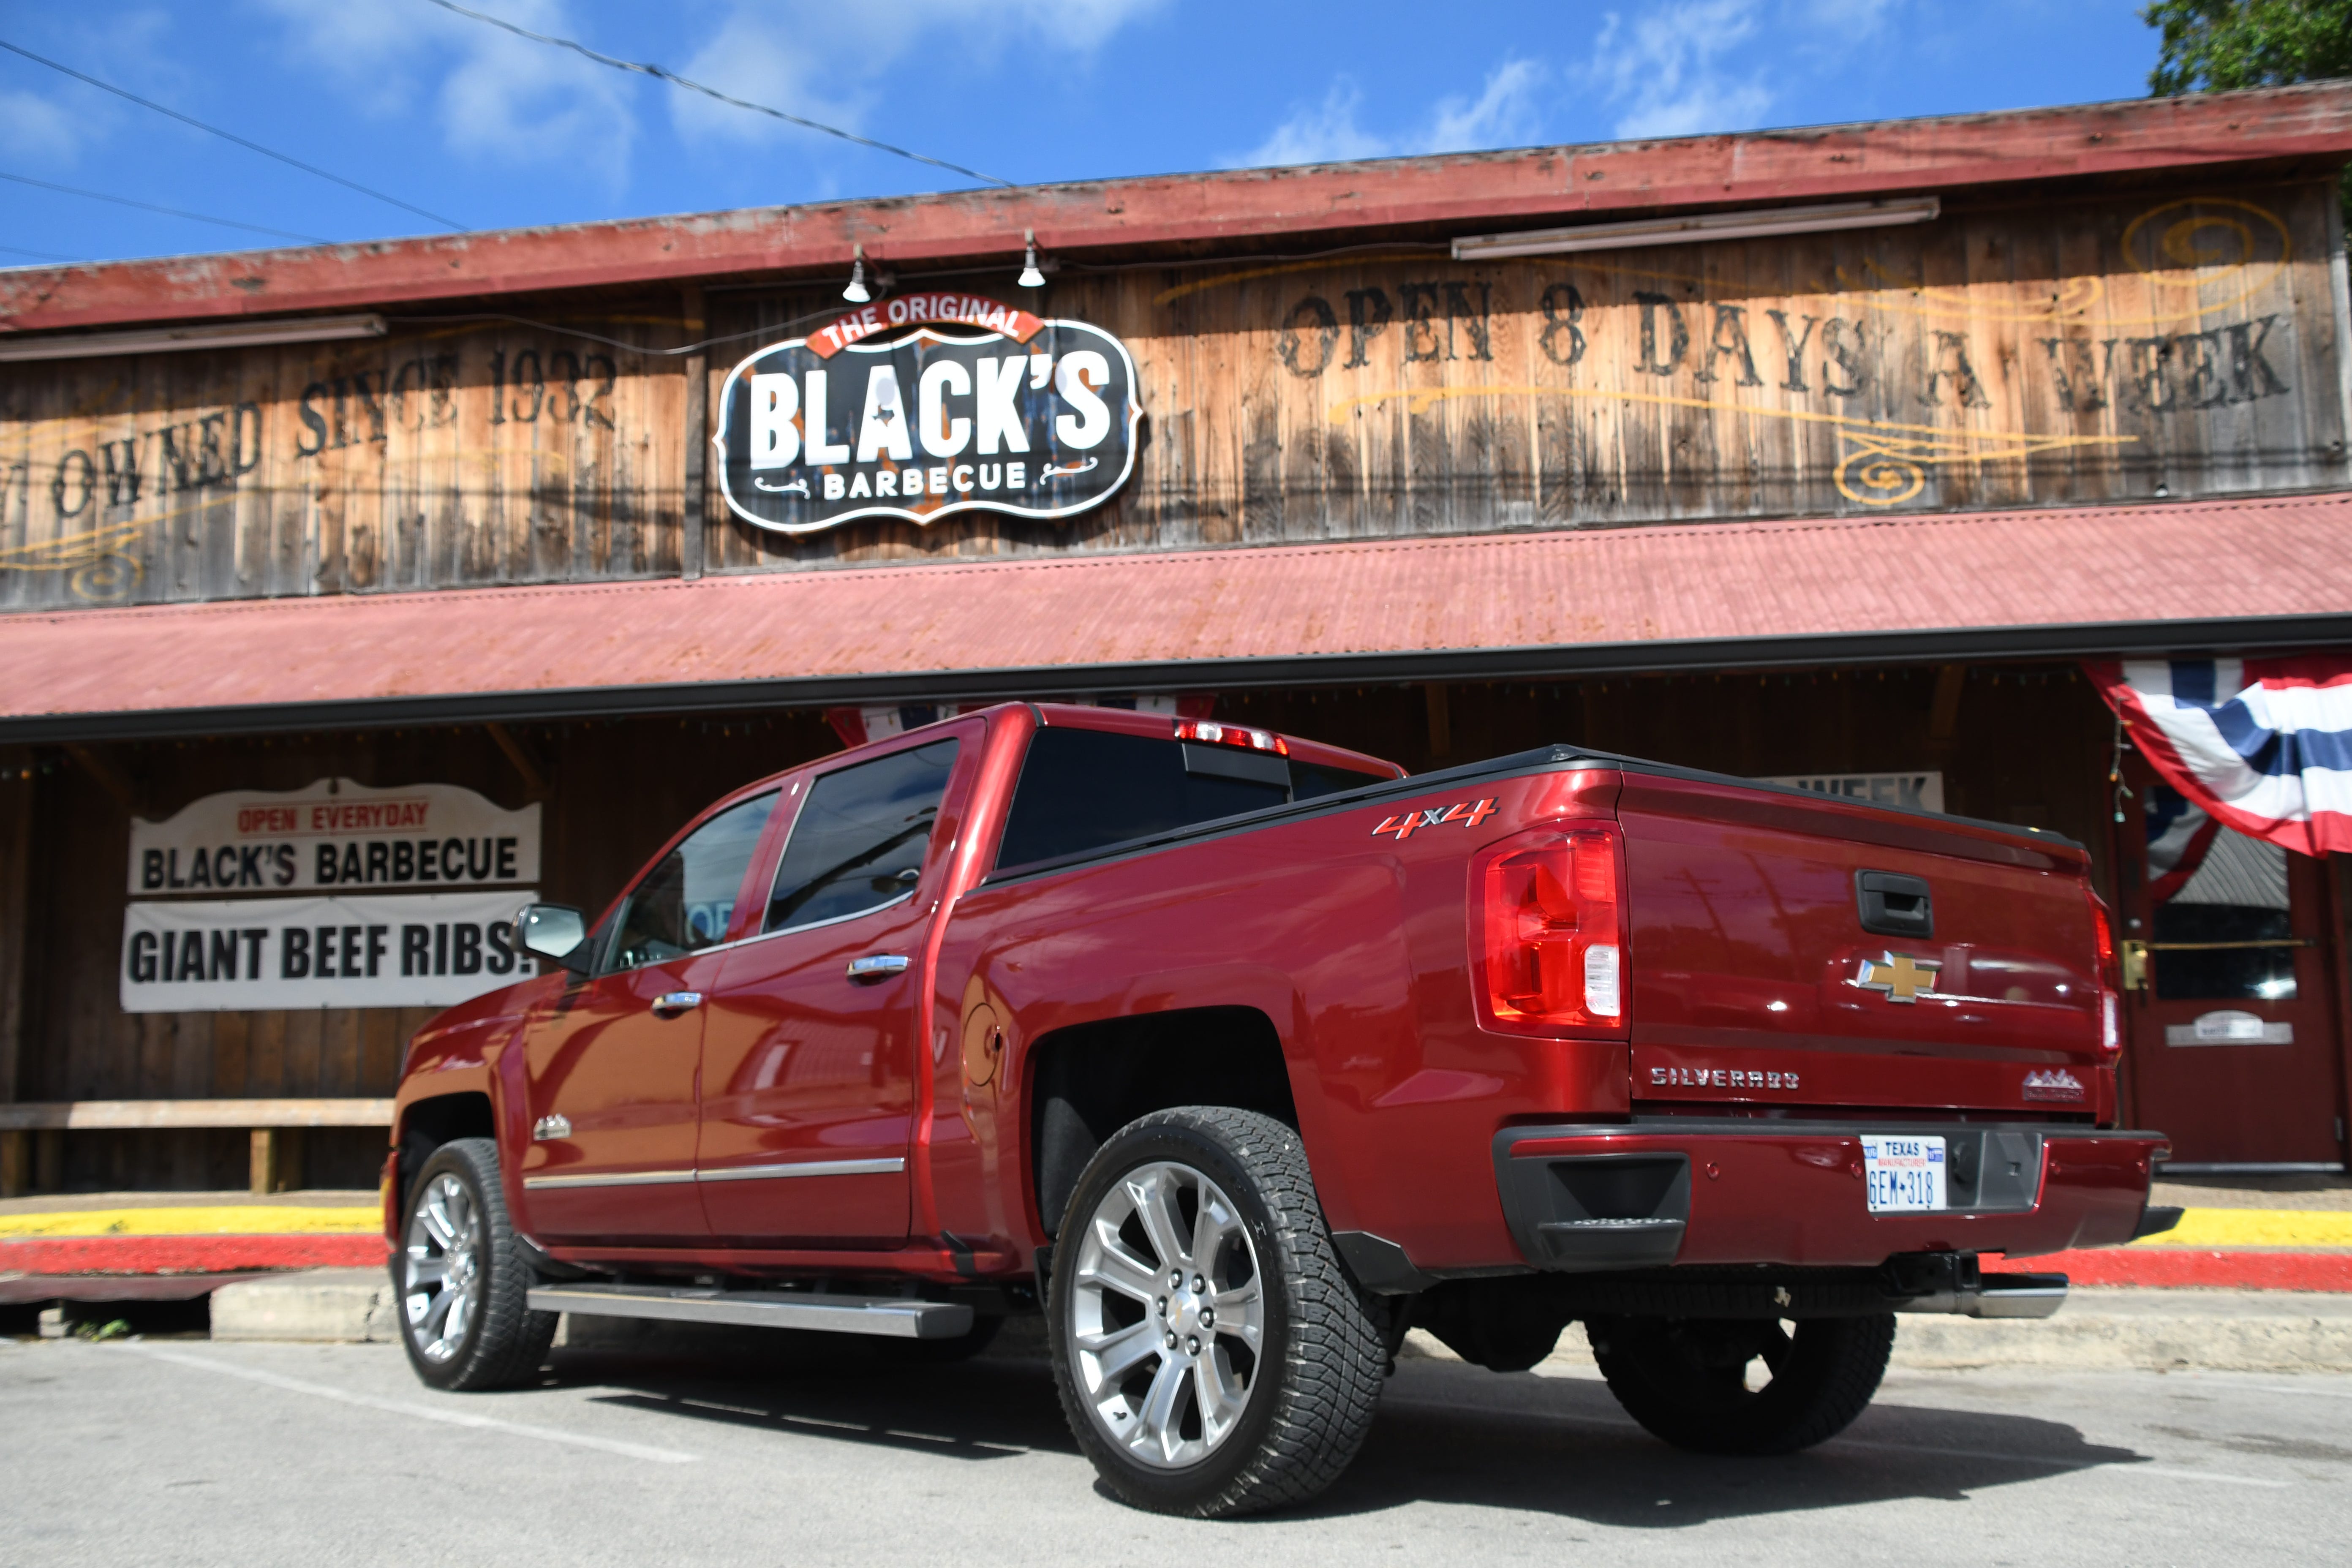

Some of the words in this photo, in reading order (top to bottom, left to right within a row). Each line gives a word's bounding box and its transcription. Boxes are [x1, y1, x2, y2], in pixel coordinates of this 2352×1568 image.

[822, 306, 881, 350] THE
[888, 295, 1020, 338] ORIGINAL
[1277, 280, 1493, 378] OPEN
[1538, 282, 1587, 366] 8
[1631, 290, 1865, 398] DAYS
[1918, 329, 1992, 410] A
[2035, 314, 2291, 414] WEEK
[51, 400, 263, 518] OWNED
[295, 351, 459, 457] SINCE
[488, 348, 617, 431] 1932
[750, 350, 1111, 470] BLACK'S
[823, 461, 1026, 500] BARBECUE
[237, 806, 298, 833] OPEN
[311, 802, 430, 831] EVERYDAY
[142, 843, 298, 890] BLACK'S
[314, 837, 519, 883] BARBECUE
[128, 928, 269, 984] GIANT
[280, 925, 389, 979] BEEF
[1651, 1067, 1800, 1089] SILVERADO
[1886, 1142, 1919, 1156] TEXAS
